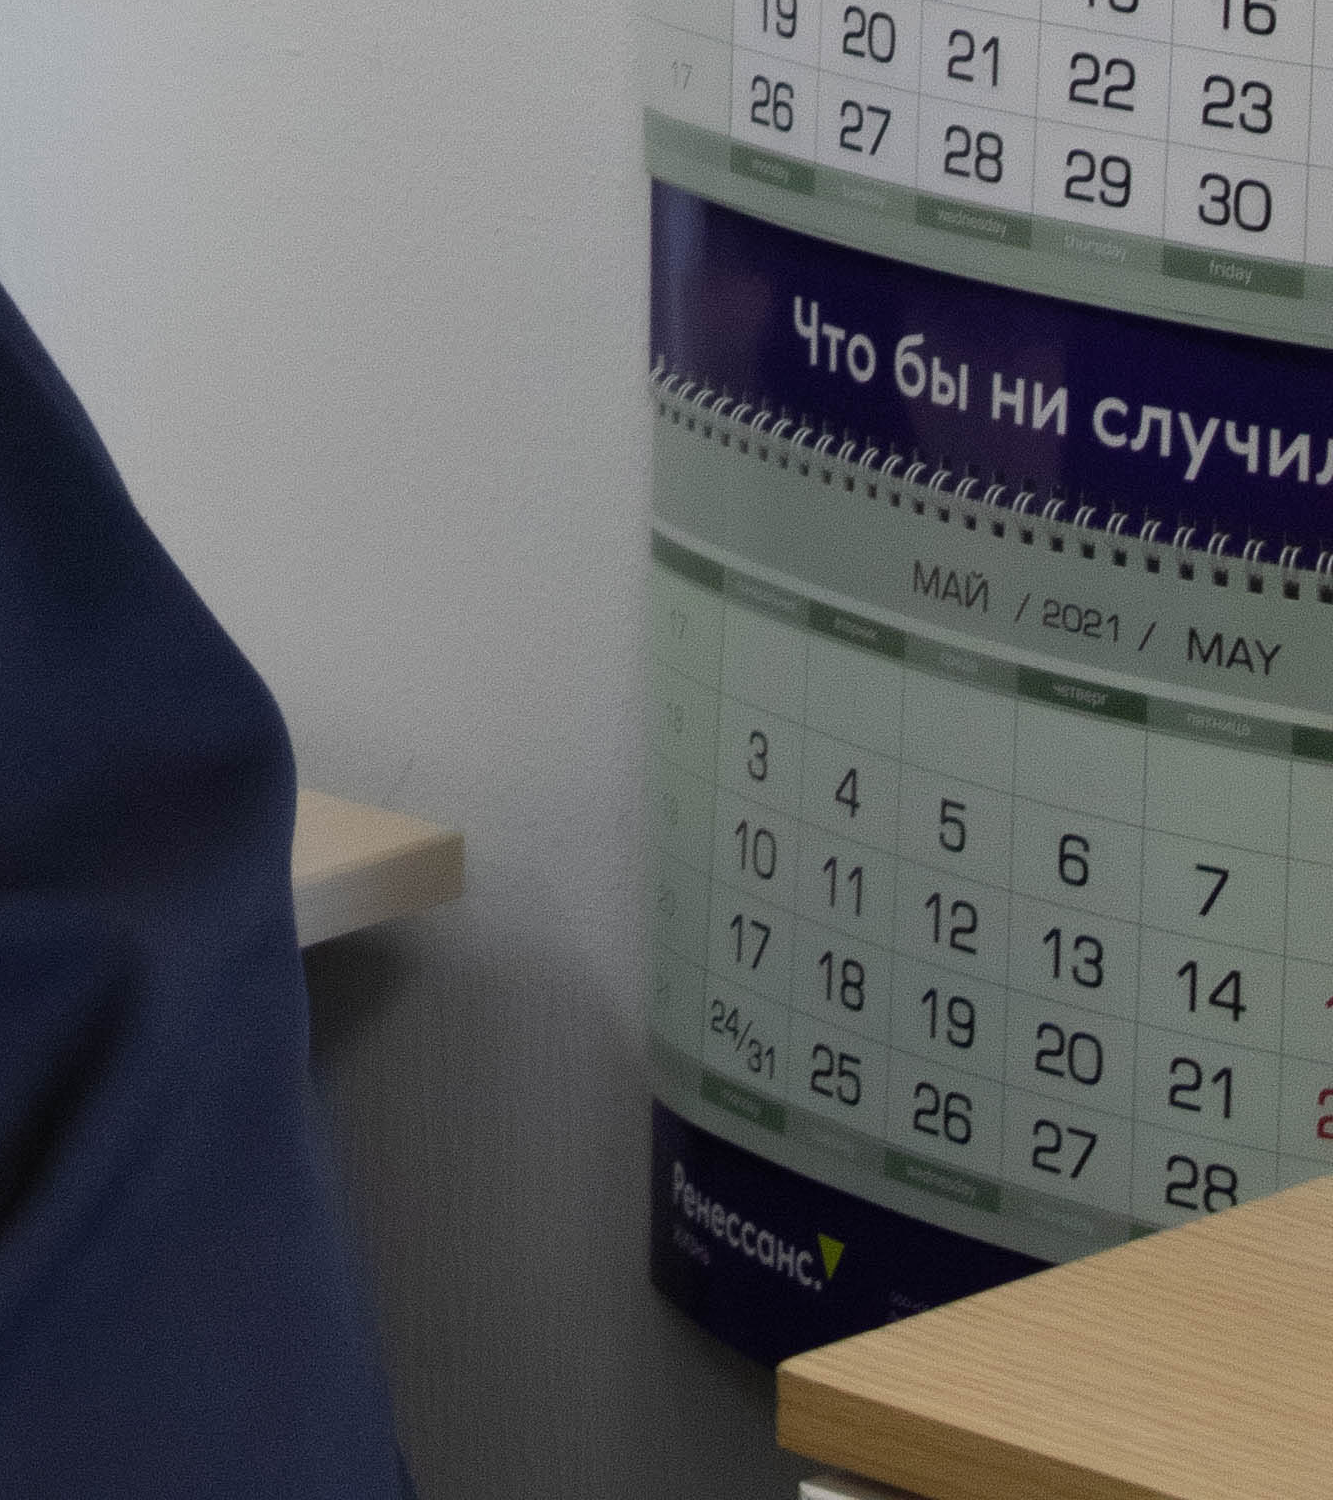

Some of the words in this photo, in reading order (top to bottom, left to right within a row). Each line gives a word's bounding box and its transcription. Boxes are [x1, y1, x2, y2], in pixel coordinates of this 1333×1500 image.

[843, 6, 895, 63] 20
[948, 30, 999, 86] 21
[1069, 53, 1135, 111] 22
[1203, 76, 1272, 134] 23
[751, 75, 793, 132] 26
[840, 100, 891, 155] 27
[945, 125, 1003, 183] 28
[1065, 150, 1131, 208] 29
[1199, 174, 1271, 232] 30
[1208, 259, 1254, 285] friday
[793, 295, 875, 383] Что
[894, 333, 969, 411] бы
[991, 372, 1068, 437] ни
[914, 561, 988, 612] МАЙ
[1043, 599, 1119, 641] 2021
[1188, 628, 1281, 675] MAY
[748, 731, 768, 782] 3
[835, 769, 860, 817] 4
[940, 799, 966, 853] 5
[1059, 834, 1089, 886] 6
[1196, 865, 1228, 916] 7
[735, 821, 776, 880] 10
[823, 857, 862, 916] 11
[926, 893, 977, 955] 12
[1044, 928, 1103, 988] 13
[1178, 961, 1246, 1021] 14
[731, 915, 770, 969] 17
[820, 952, 864, 1012] 18
[922, 989, 975, 1049] 19
[1036, 1023, 1103, 1085] 20
[1169, 1058, 1232, 1118] 21
[710, 1000, 774, 1085] 24/31
[811, 1044, 861, 1106] 25
[914, 1082, 972, 1145] 26
[1033, 1120, 1097, 1178] 27
[1166, 1155, 1238, 1213] 28
